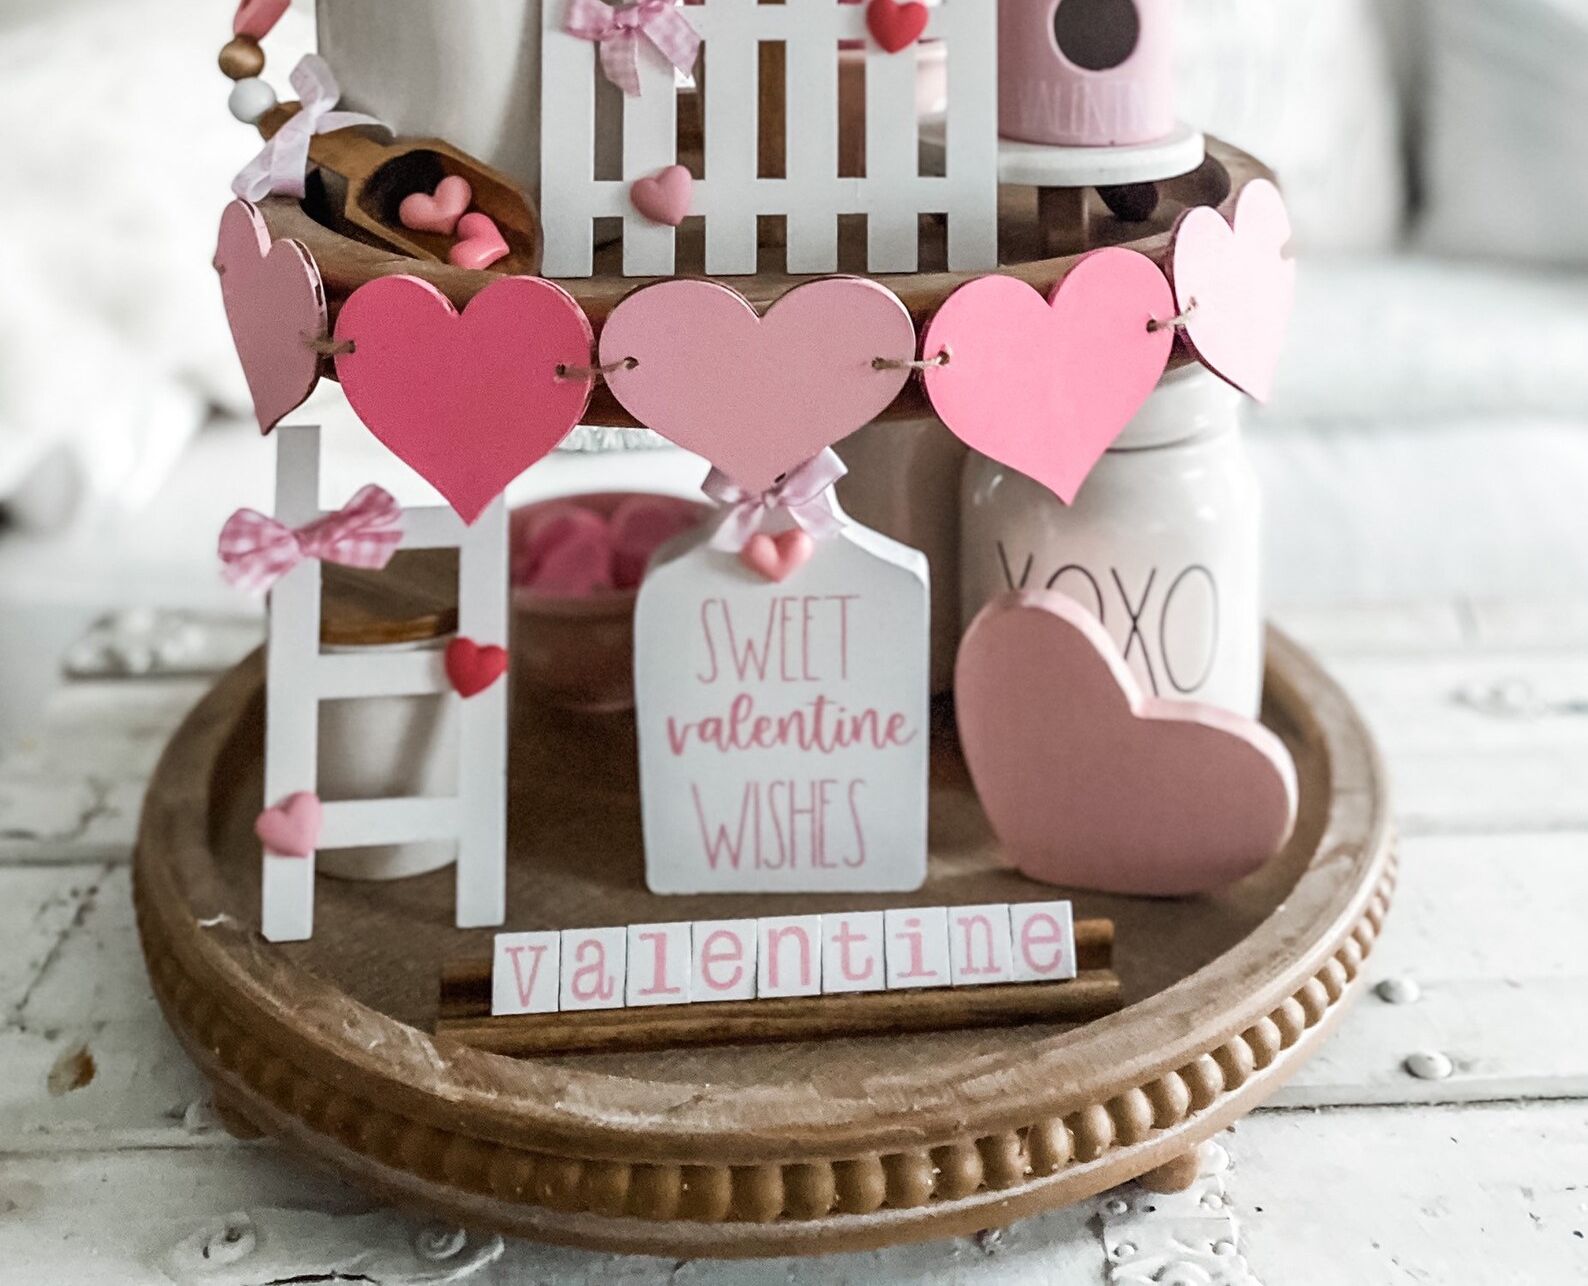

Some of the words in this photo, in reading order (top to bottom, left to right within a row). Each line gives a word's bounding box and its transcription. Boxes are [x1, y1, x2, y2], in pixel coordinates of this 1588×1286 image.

[697, 594, 861, 684] SWEET
[665, 693, 919, 757] valentine
[692, 778, 867, 871] WISHES
[504, 909, 1064, 1008] valentine
